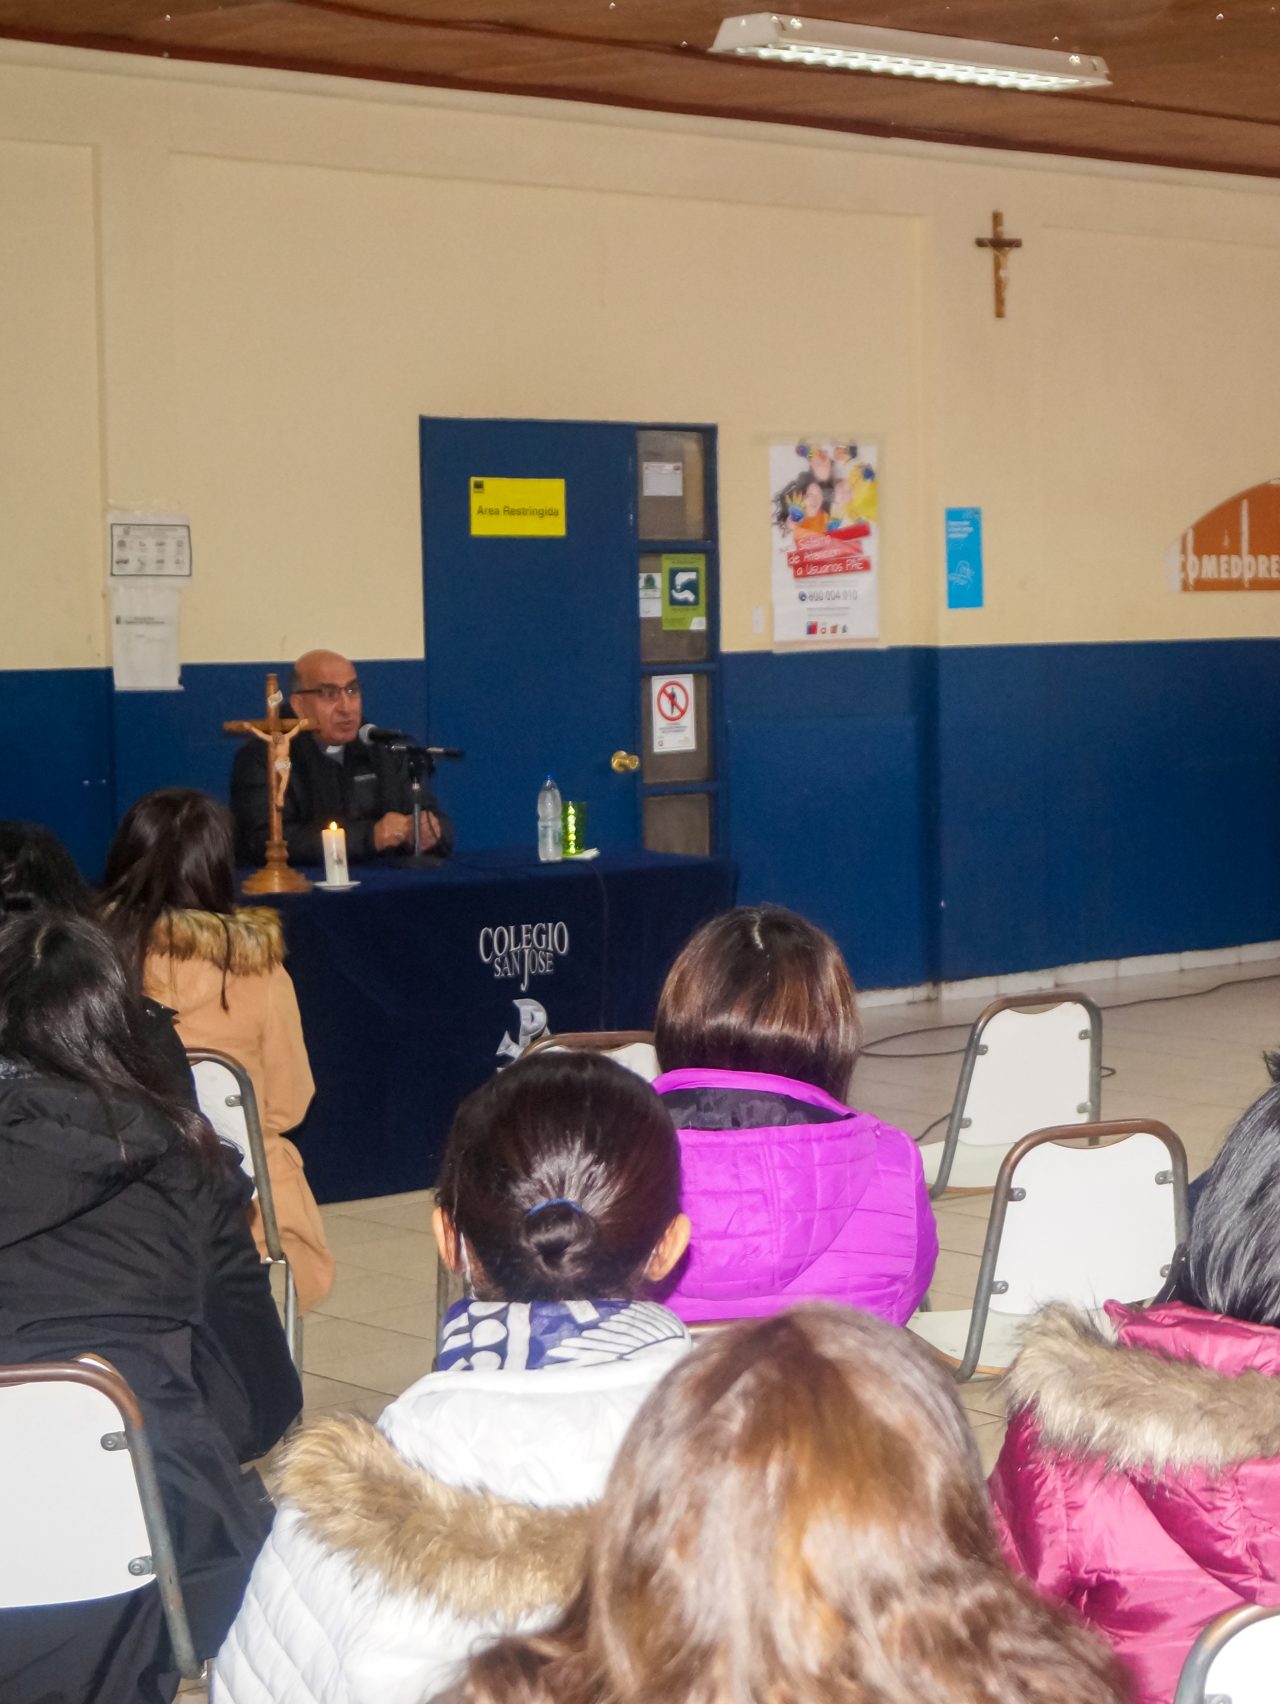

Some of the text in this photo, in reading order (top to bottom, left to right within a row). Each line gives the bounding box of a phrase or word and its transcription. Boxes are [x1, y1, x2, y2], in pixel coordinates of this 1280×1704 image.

[477, 505, 559, 518] Area Restringida
[479, 921, 569, 962] COLEGIO
[494, 948, 554, 992] SAN JOSE
